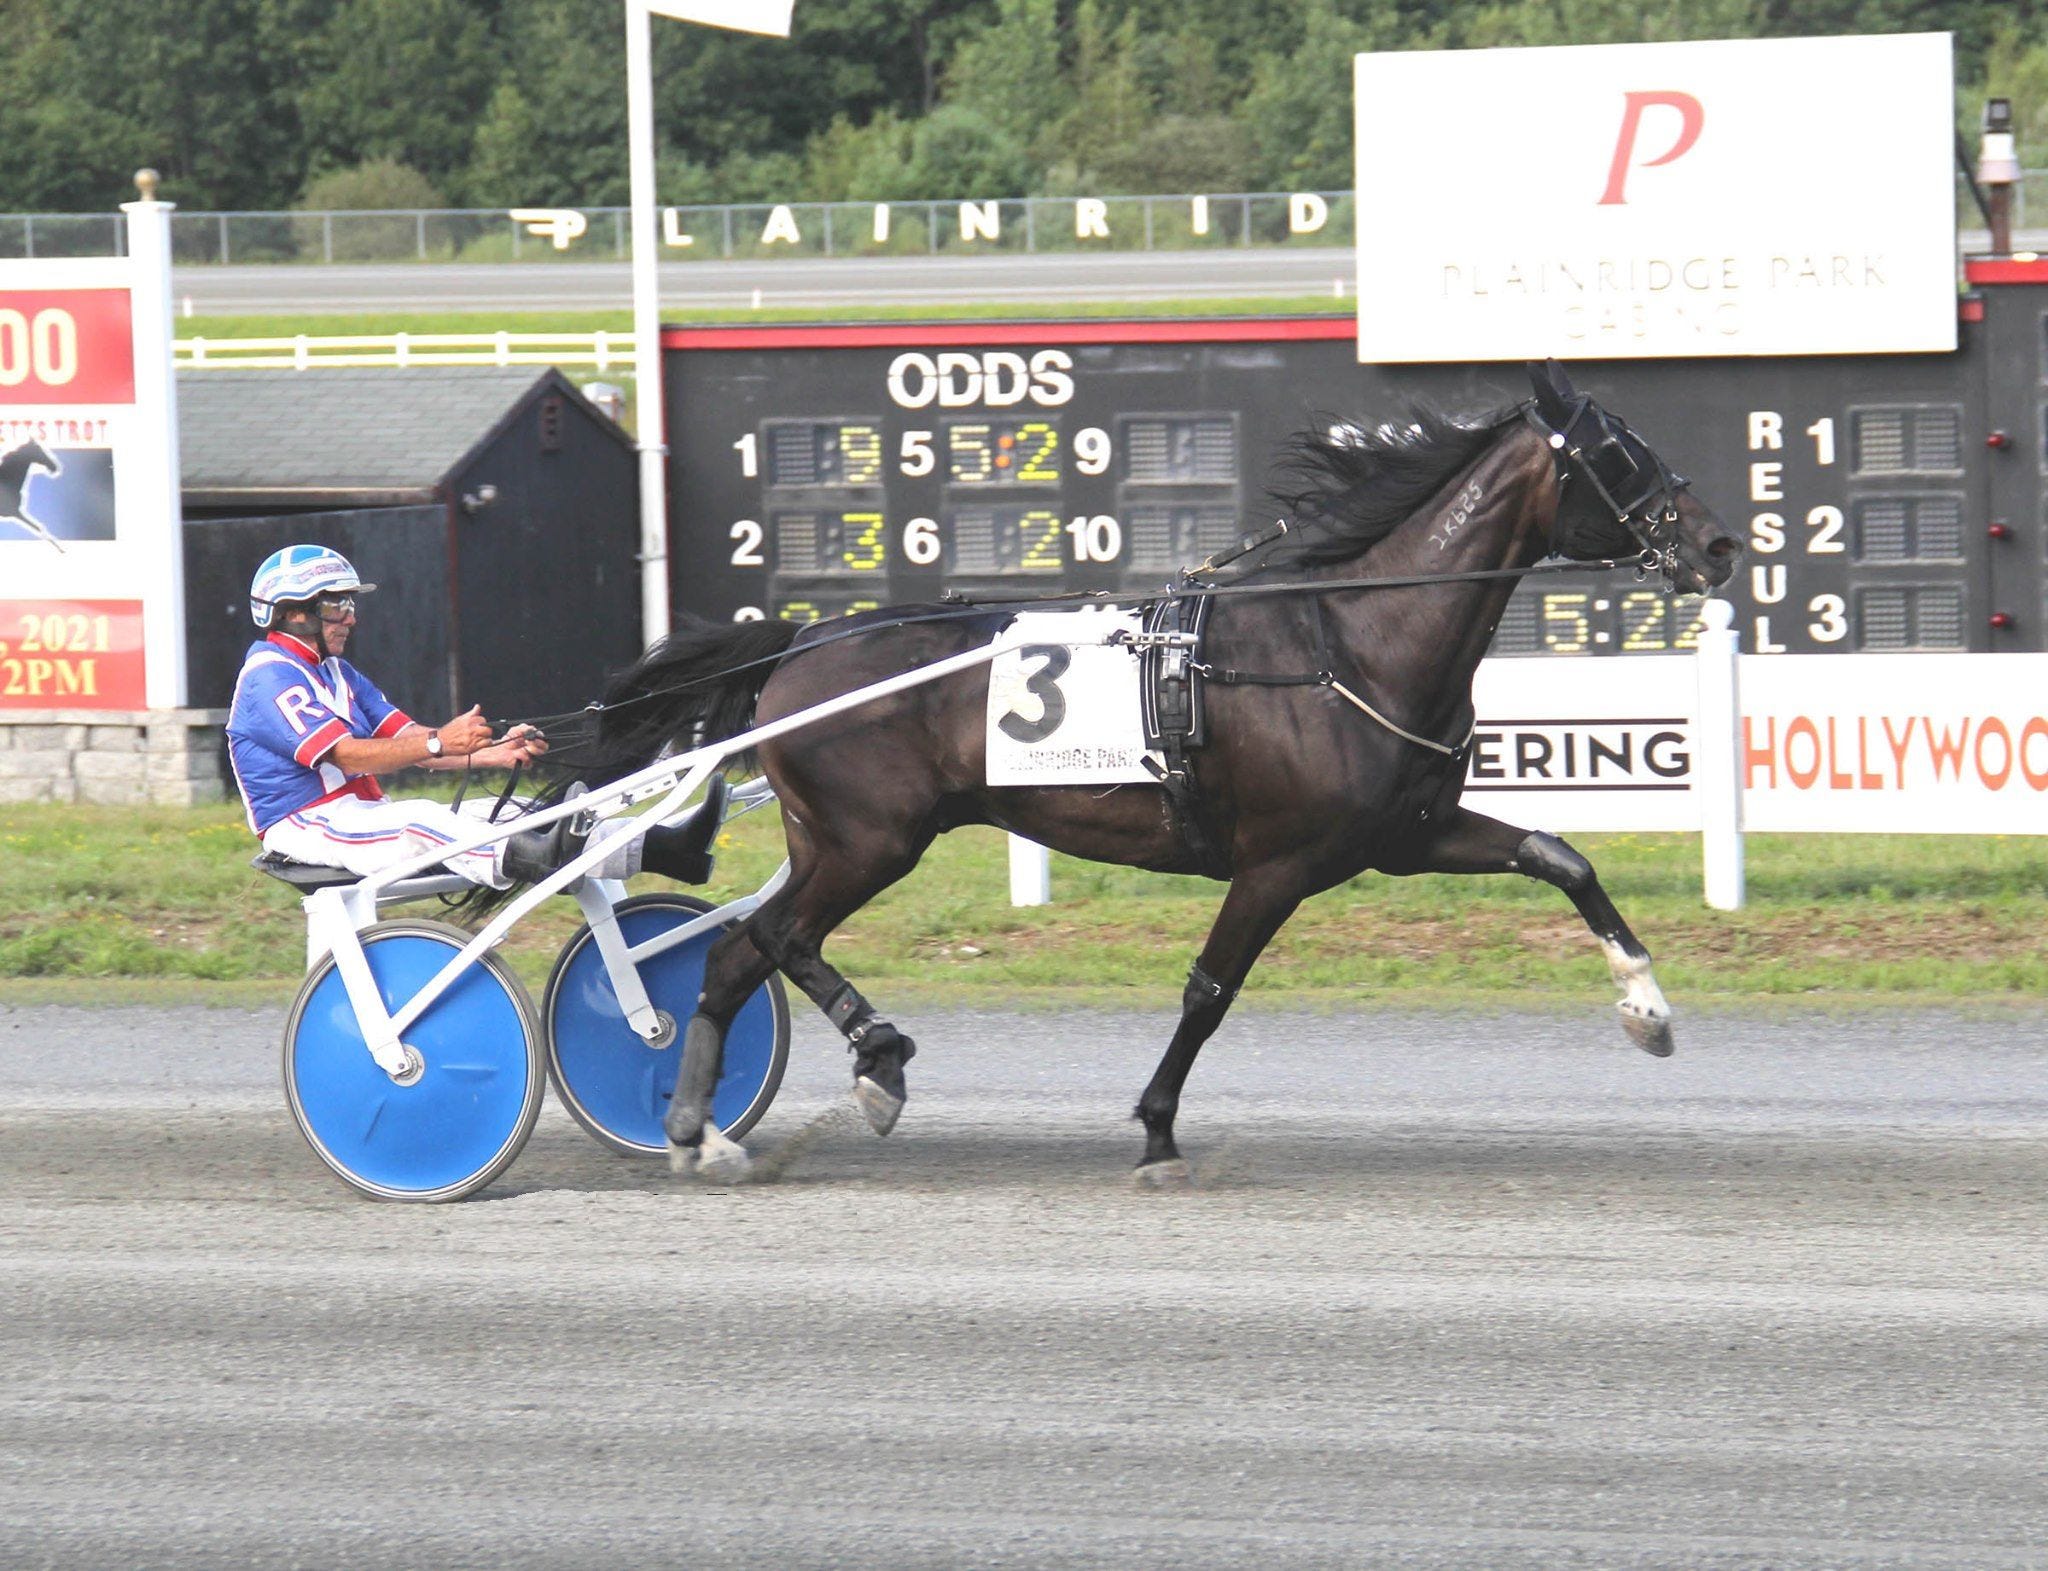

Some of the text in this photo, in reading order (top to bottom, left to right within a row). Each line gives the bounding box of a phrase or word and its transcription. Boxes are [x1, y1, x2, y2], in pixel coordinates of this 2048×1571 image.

[1597, 90, 1705, 205] P
[1443, 254, 1886, 296] PLAINRIDGE PARK
[1564, 303, 1740, 339] CASNO
[887, 350, 1075, 408] ODDS
[54, 419, 107, 443] TROT
[900, 431, 935, 476] 5
[949, 424, 1058, 480] 5:2
[1074, 428, 1112, 475] 9
[1807, 418, 1836, 465] 1
[733, 434, 757, 477] 1
[730, 521, 763, 565] 2
[841, 513, 884, 569] 3
[903, 518, 941, 564] 6
[1020, 511, 1062, 566] 2
[1065, 516, 1121, 562] 10
[1807, 505, 1845, 553] 2
[20, 616, 109, 652] 2021
[1808, 594, 1848, 642] 3
[3, 660, 97, 696] 2PM
[998, 644, 1072, 743] 3
[275, 685, 326, 736] R
[1471, 731, 1691, 778] ERING
